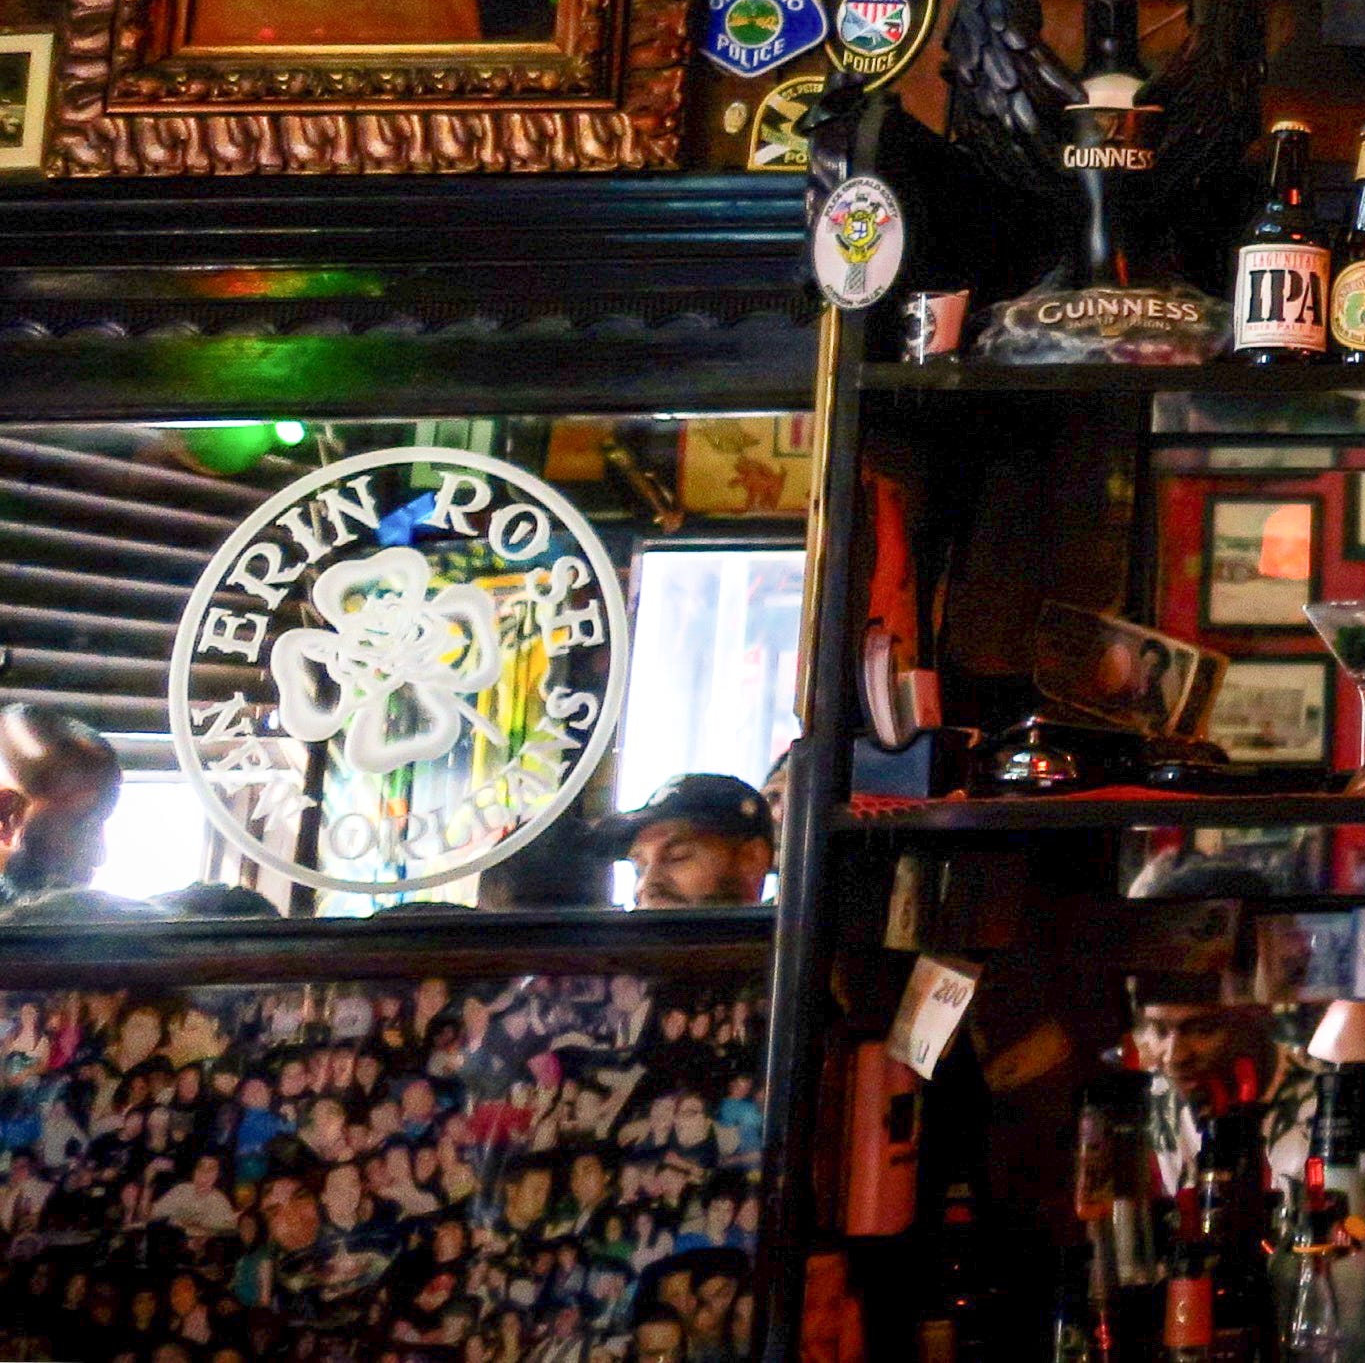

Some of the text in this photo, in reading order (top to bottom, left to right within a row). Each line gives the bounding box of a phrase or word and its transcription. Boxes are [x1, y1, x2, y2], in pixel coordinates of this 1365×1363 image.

[716, 33, 785, 68] POLICE
[842, 51, 898, 72] POLICE
[1063, 145, 1155, 170] GUINNESS
[1038, 299, 1200, 325] GUINNESS
[1246, 269, 1324, 328] IPA
[200, 470, 605, 663] ERIN ROSE
[193, 691, 316, 832] NEW
[931, 976, 971, 1009] 200
